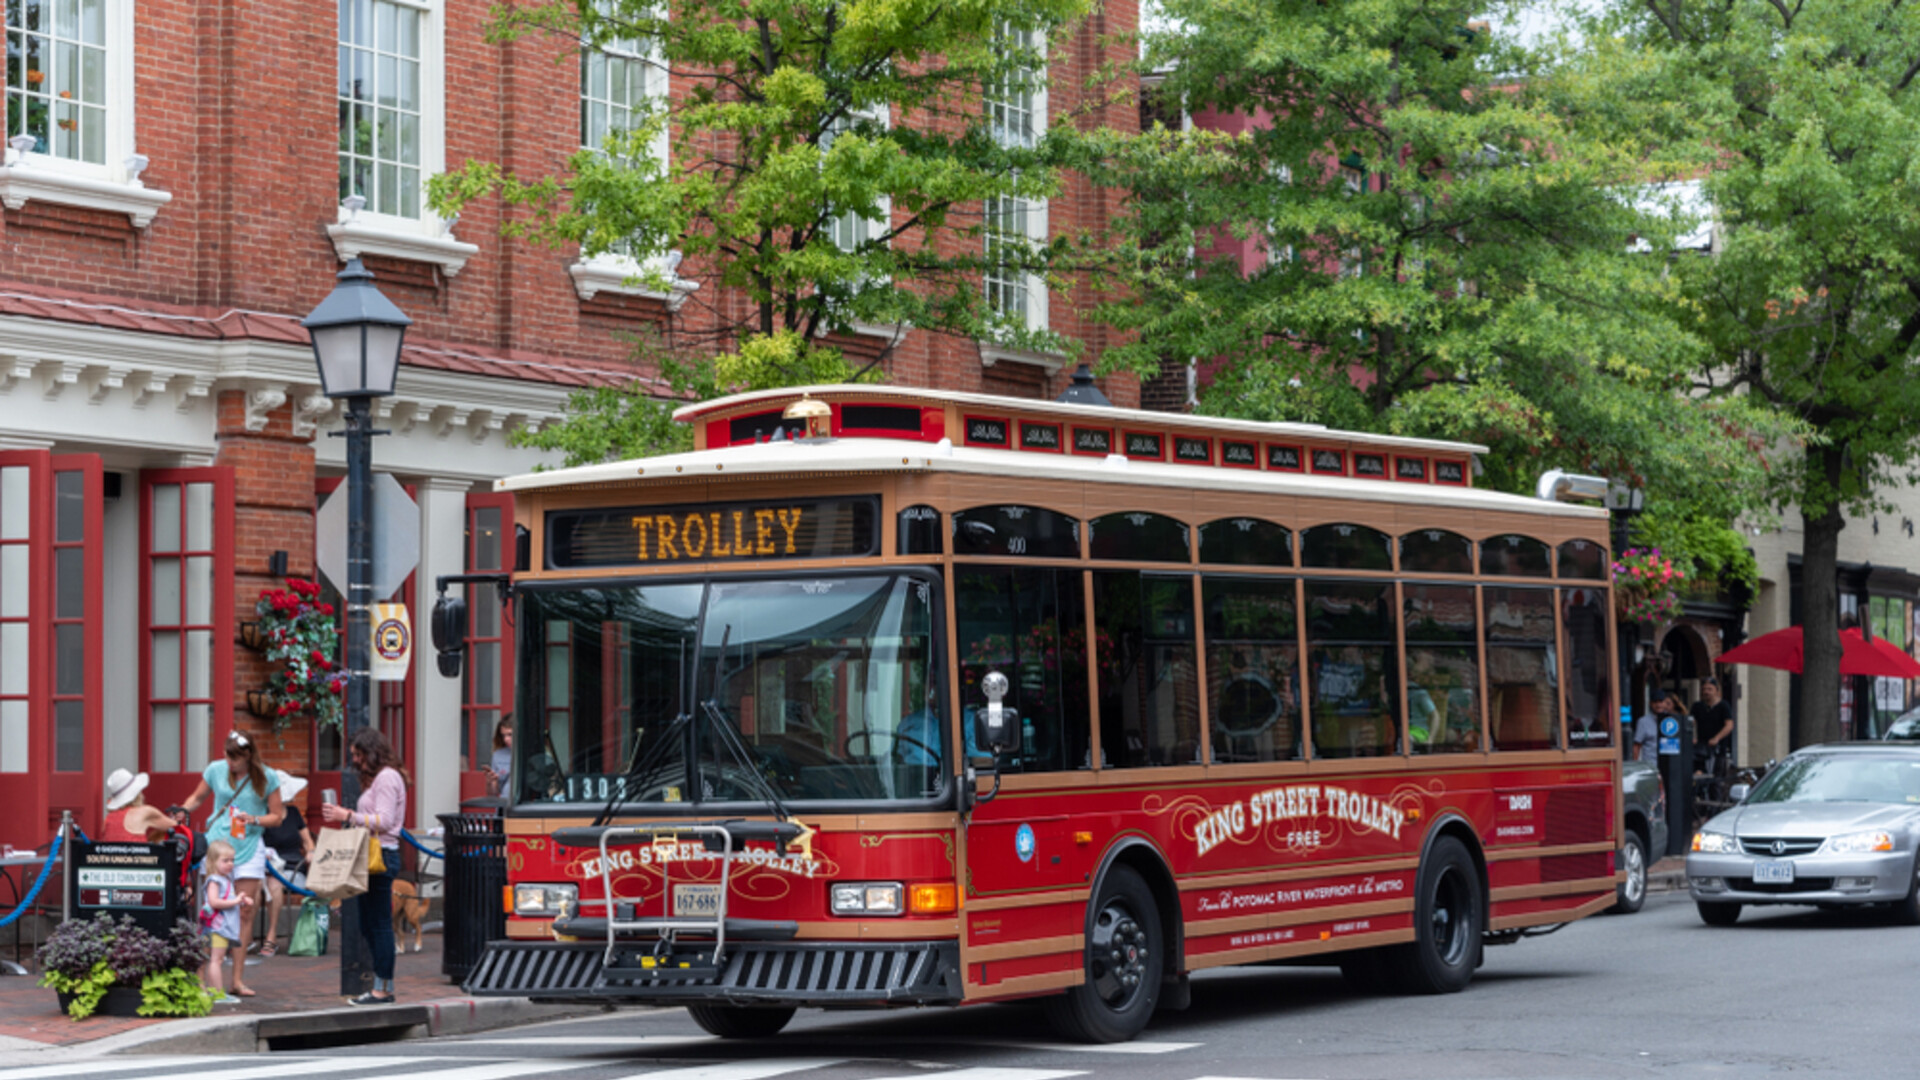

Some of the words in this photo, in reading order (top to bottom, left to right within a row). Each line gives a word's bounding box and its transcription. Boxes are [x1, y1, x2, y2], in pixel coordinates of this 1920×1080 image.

[631, 507, 802, 560] TROLLEY
[1007, 536, 1027, 554] 400
[567, 777, 627, 800] 1303
[1509, 794, 1533, 811] DASH
[1194, 800, 1246, 857] KING
[1251, 784, 1321, 828] STREET
[1324, 784, 1404, 841] TROLLEY
[1286, 830, 1321, 847] FREE
[86, 854, 110, 864] SOUTH
[111, 854, 133, 864] UNION
[134, 855, 159, 864] STREET
[581, 849, 633, 879] KING
[728, 845, 821, 878] ROLLEY
[90, 871, 101, 882] THE
[103, 872, 115, 883] OLD
[117, 872, 135, 883] TOWN
[1232, 892, 1275, 908] POTOMAC
[1276, 890, 1302, 903] RIVER
[1303, 883, 1356, 900] WATERFRONT
[1375, 879, 1404, 893] METRO
